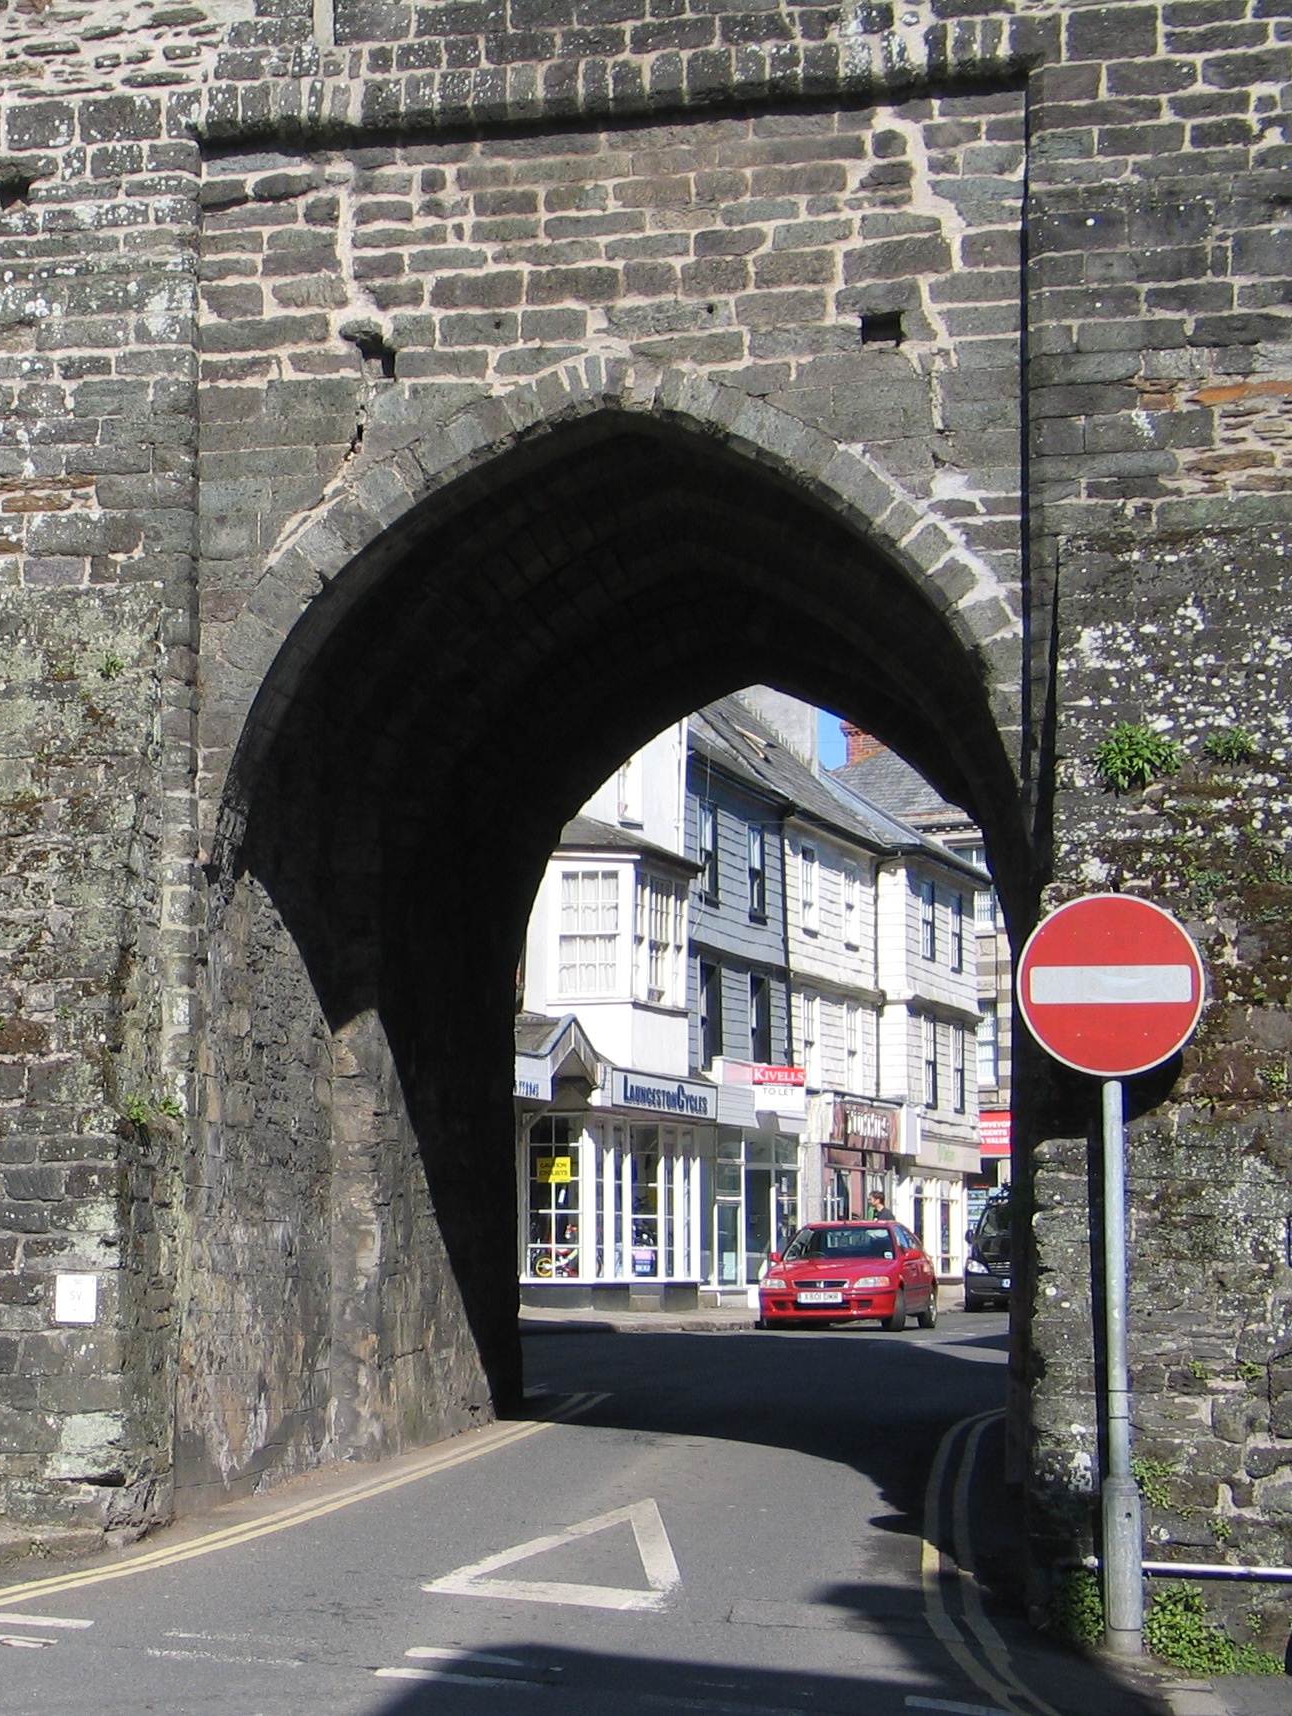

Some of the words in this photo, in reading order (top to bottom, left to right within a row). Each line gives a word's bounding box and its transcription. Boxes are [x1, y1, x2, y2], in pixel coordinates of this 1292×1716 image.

[753, 1067, 804, 1082] KIVELLS
[762, 1087, 776, 1096] TO
[778, 1087, 795, 1097] LET
